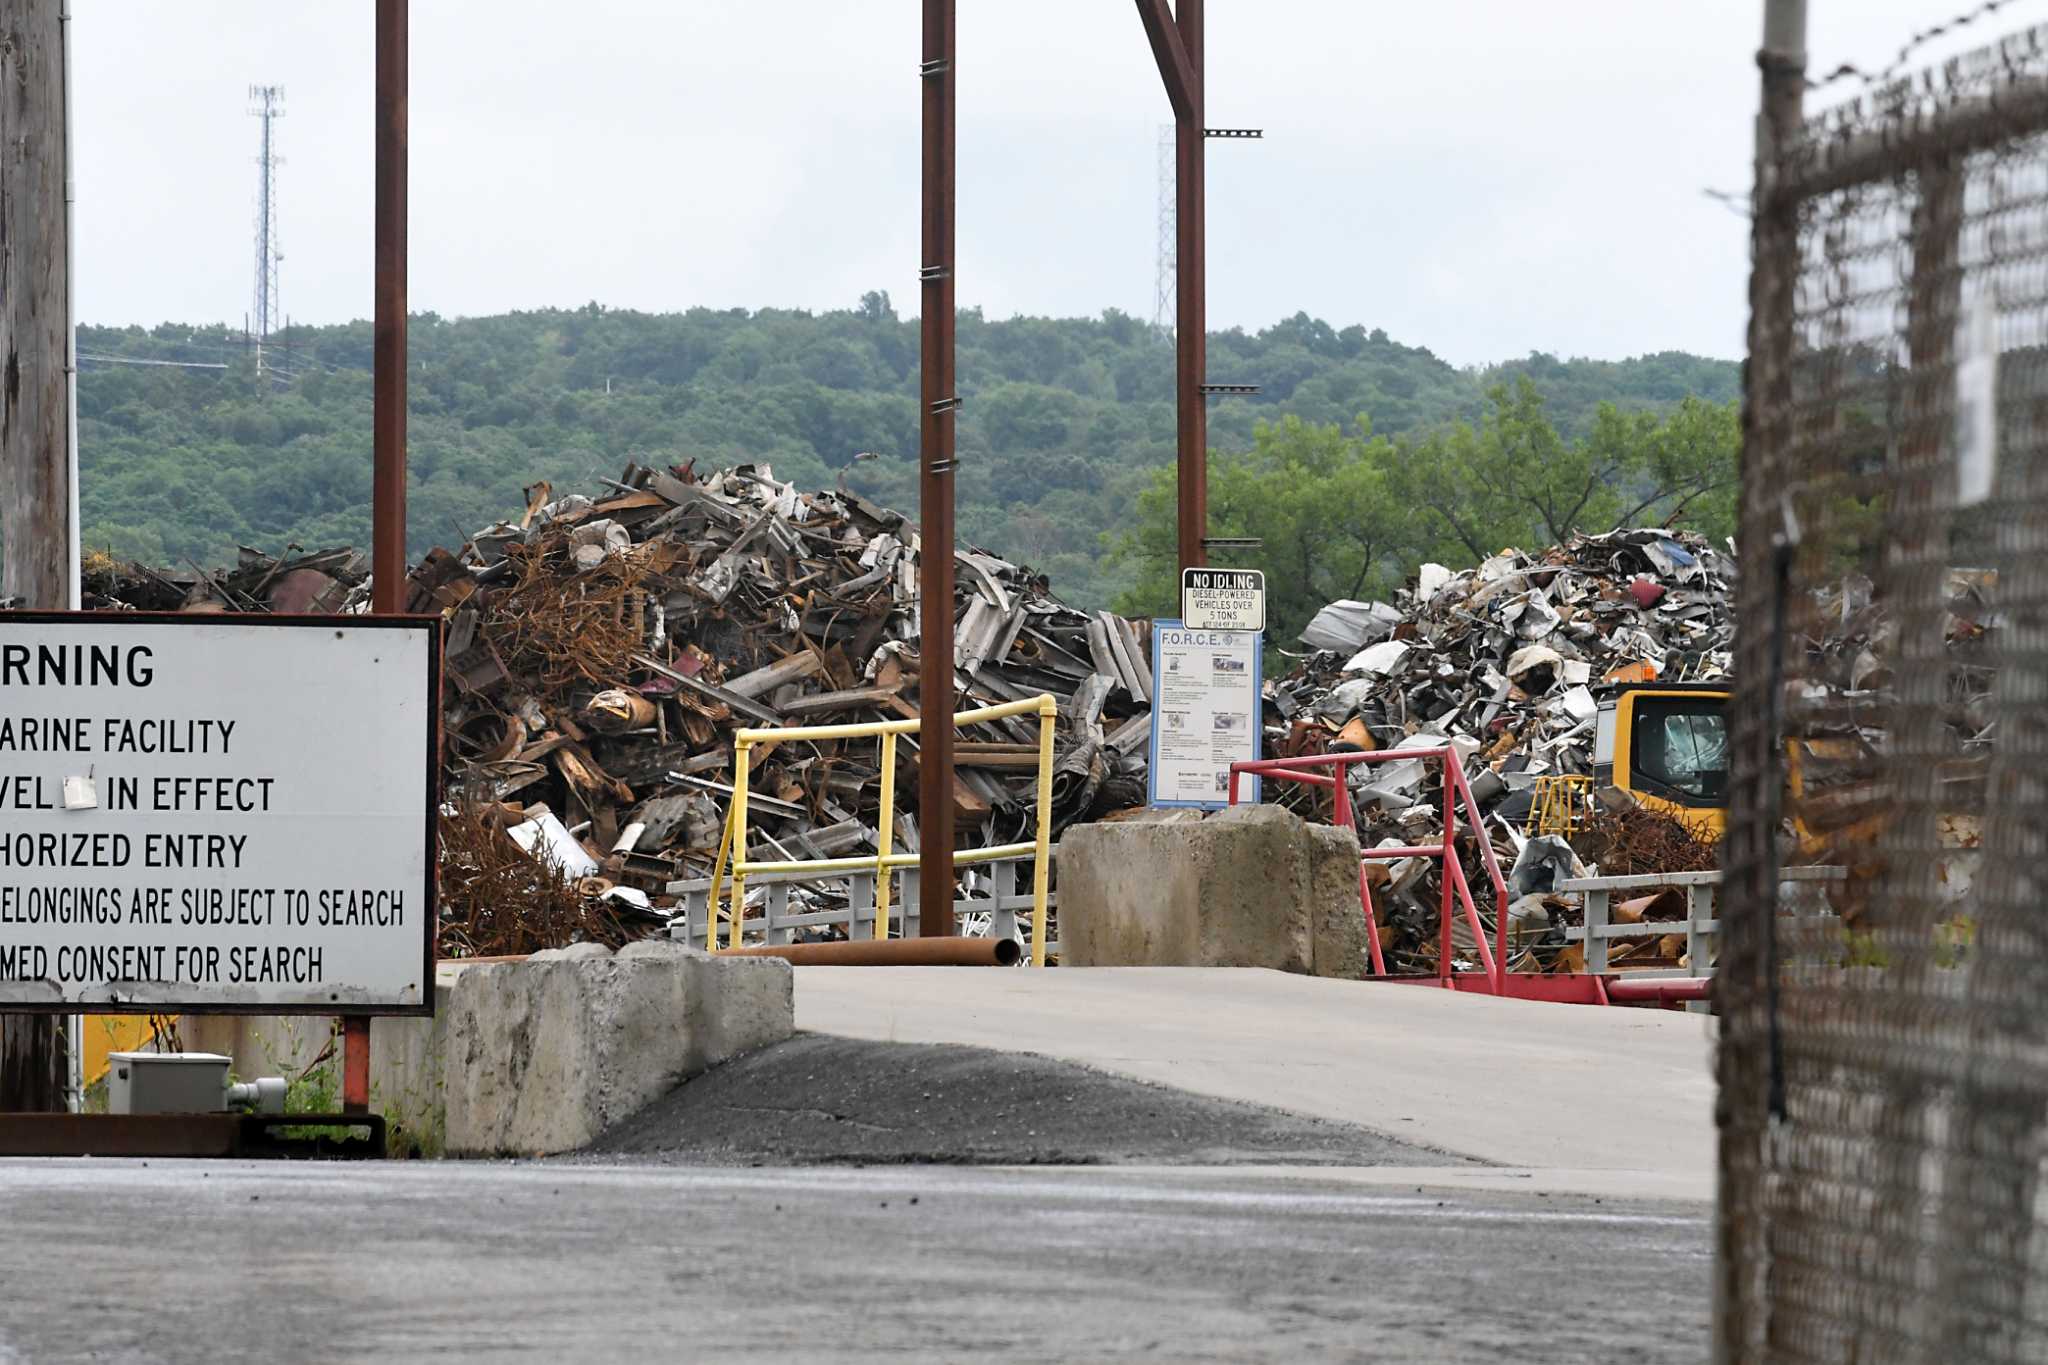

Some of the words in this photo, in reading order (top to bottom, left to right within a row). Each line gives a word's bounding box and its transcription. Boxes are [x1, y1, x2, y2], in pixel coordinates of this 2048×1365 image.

[1192, 589, 1256, 600] DIESEL-POWERED
[1193, 573, 1210, 588] NO
[1213, 574, 1254, 589] IDLING
[1195, 600, 1231, 610] VEHICLES
[1233, 601, 1253, 610] OVER
[1209, 610, 1216, 620] 5
[1217, 611, 1238, 620] TONS
[1162, 632, 1221, 646] F.O.R.C.E.
[2, 645, 153, 687] RNING
[0, 718, 92, 752] ARINE
[104, 719, 236, 753] FACILITY
[107, 777, 138, 810] IN
[153, 778, 275, 811] EFFECT
[145, 834, 248, 868] ENTRY
[2, 887, 122, 924] ELONGINGS
[129, 888, 173, 924] ARE
[180, 888, 276, 926] SUBJECT
[283, 889, 310, 926] TO
[318, 889, 403, 926] SEARCH
[0, 945, 48, 981] MED
[57, 945, 166, 982] CONSENT
[175, 946, 220, 983] FOR
[229, 946, 323, 983] SEARCH
